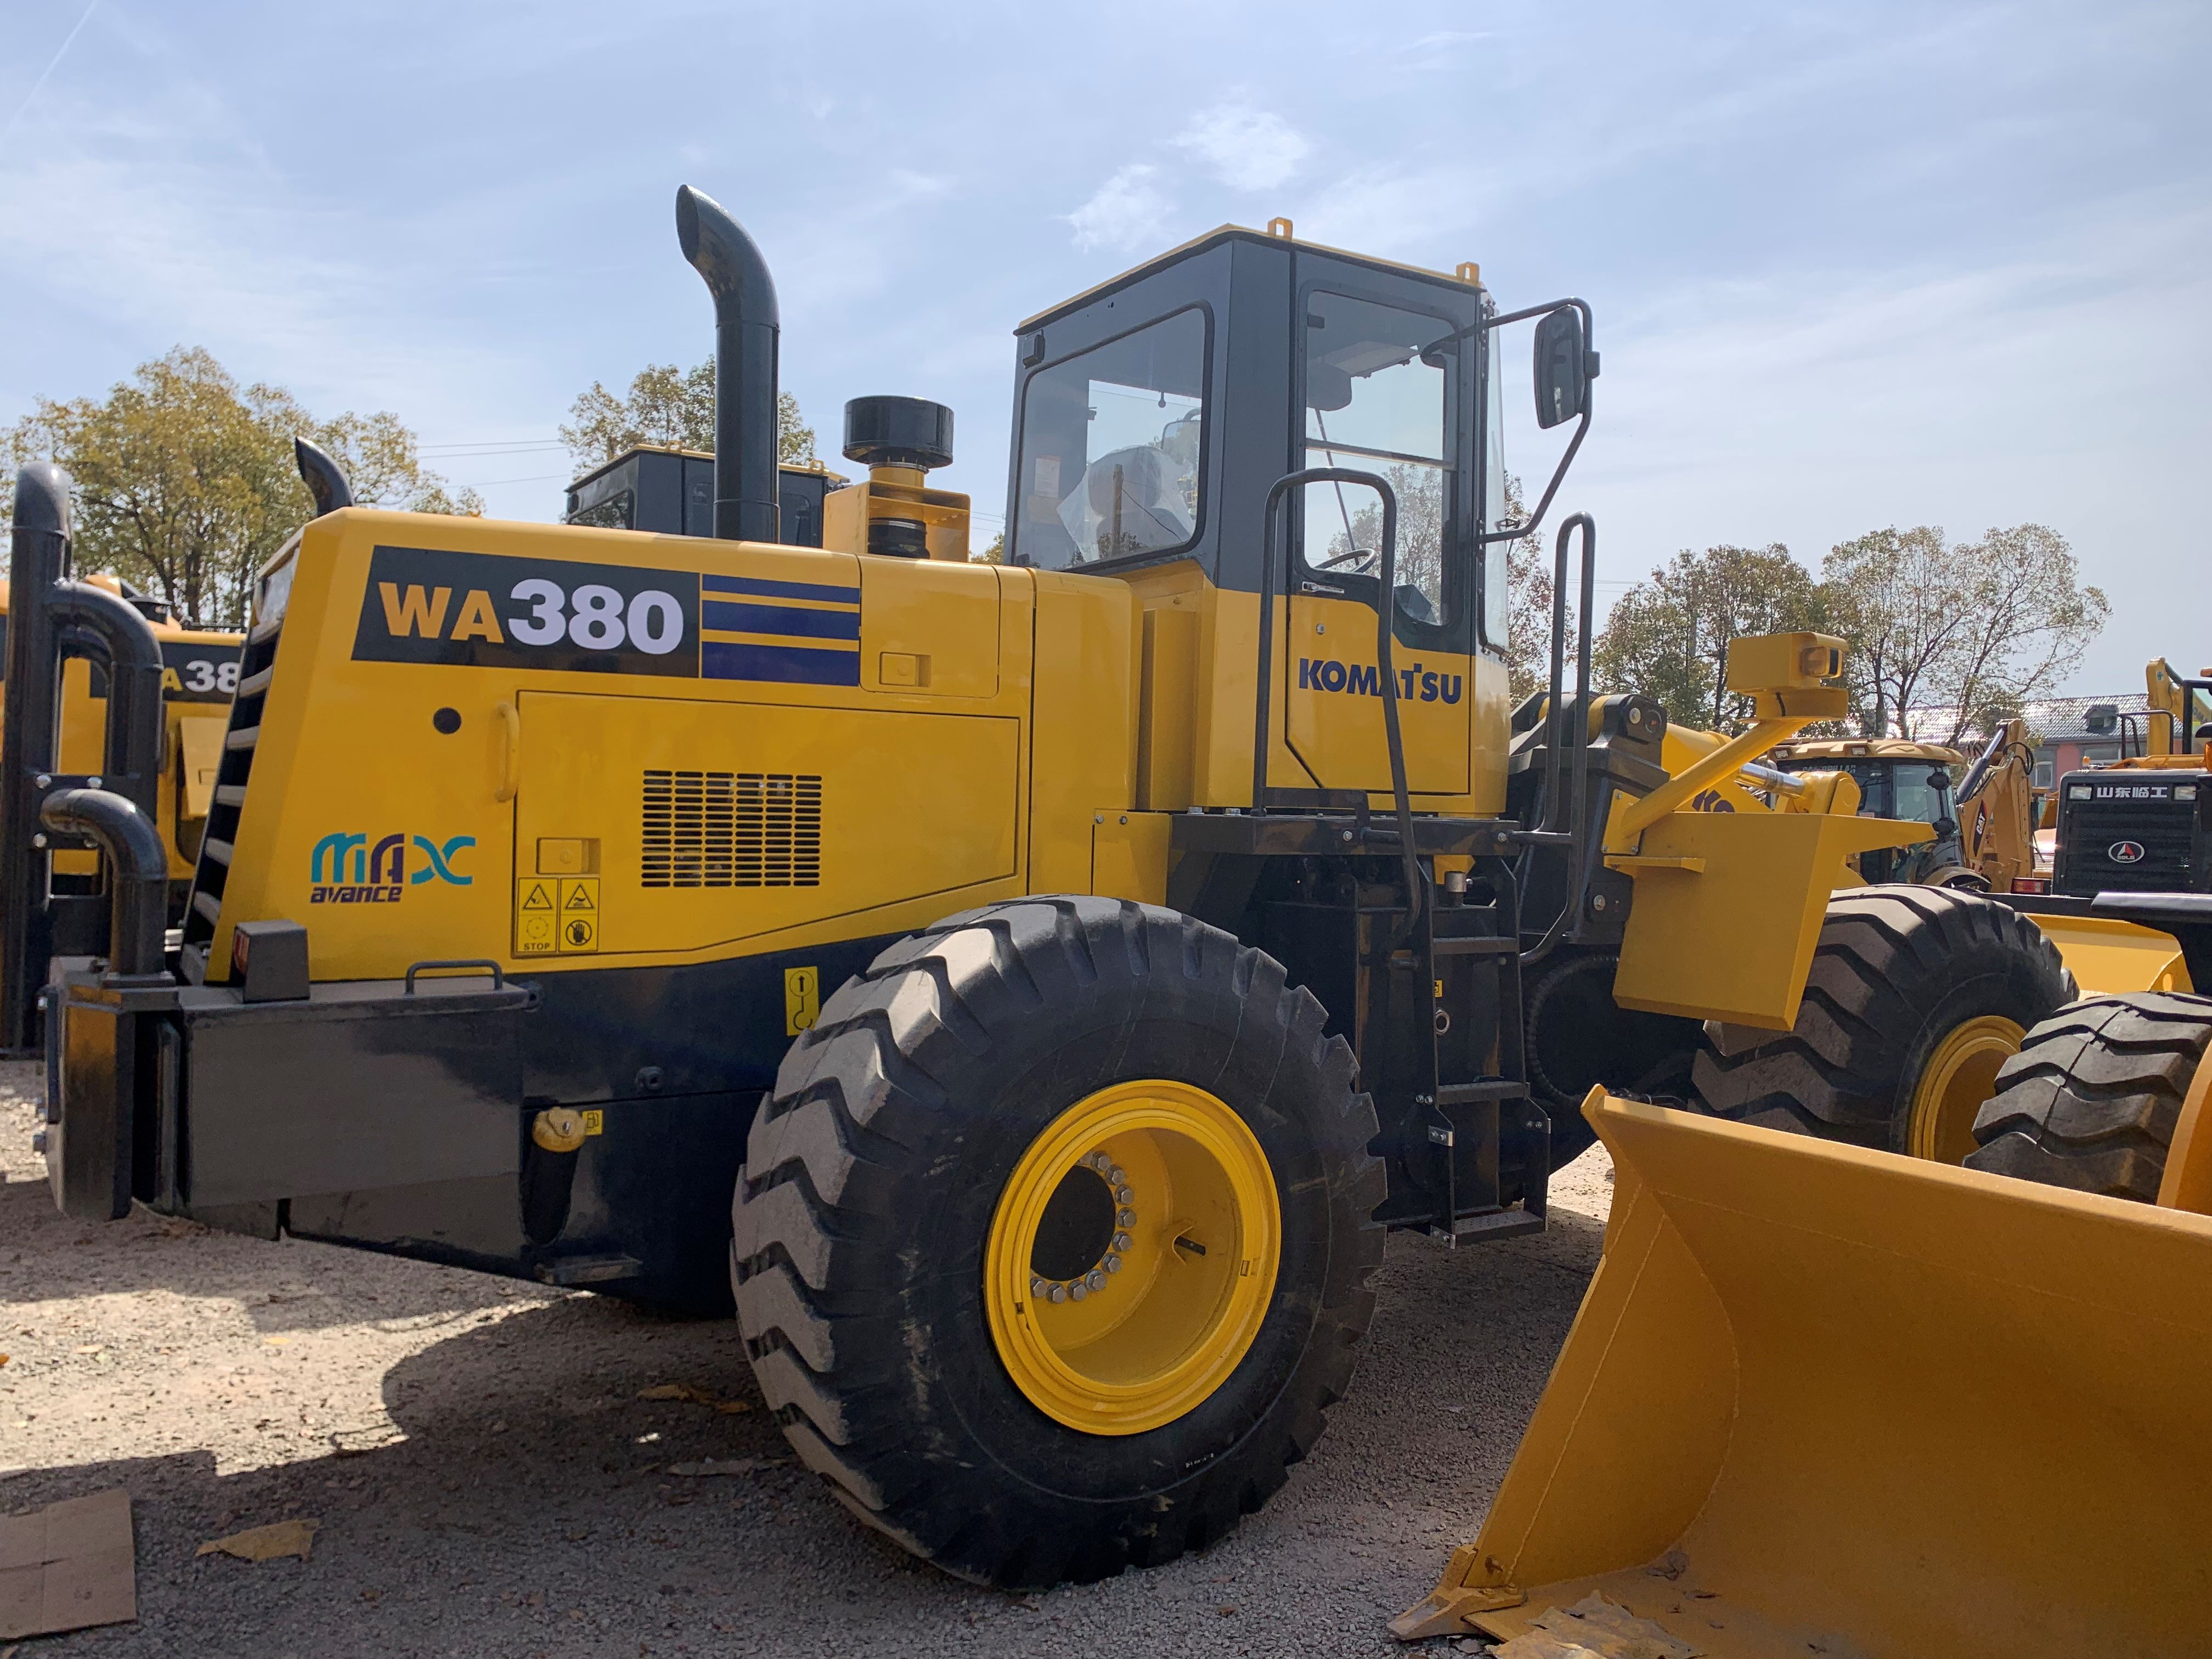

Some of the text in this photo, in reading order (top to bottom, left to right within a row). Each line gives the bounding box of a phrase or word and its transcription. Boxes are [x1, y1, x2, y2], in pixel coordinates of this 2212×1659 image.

[378, 578, 685, 655] WA380
[2096, 786, 2168, 798] 山东临工
[1976, 812, 1985, 835] CAT
[309, 885, 403, 904] avance
